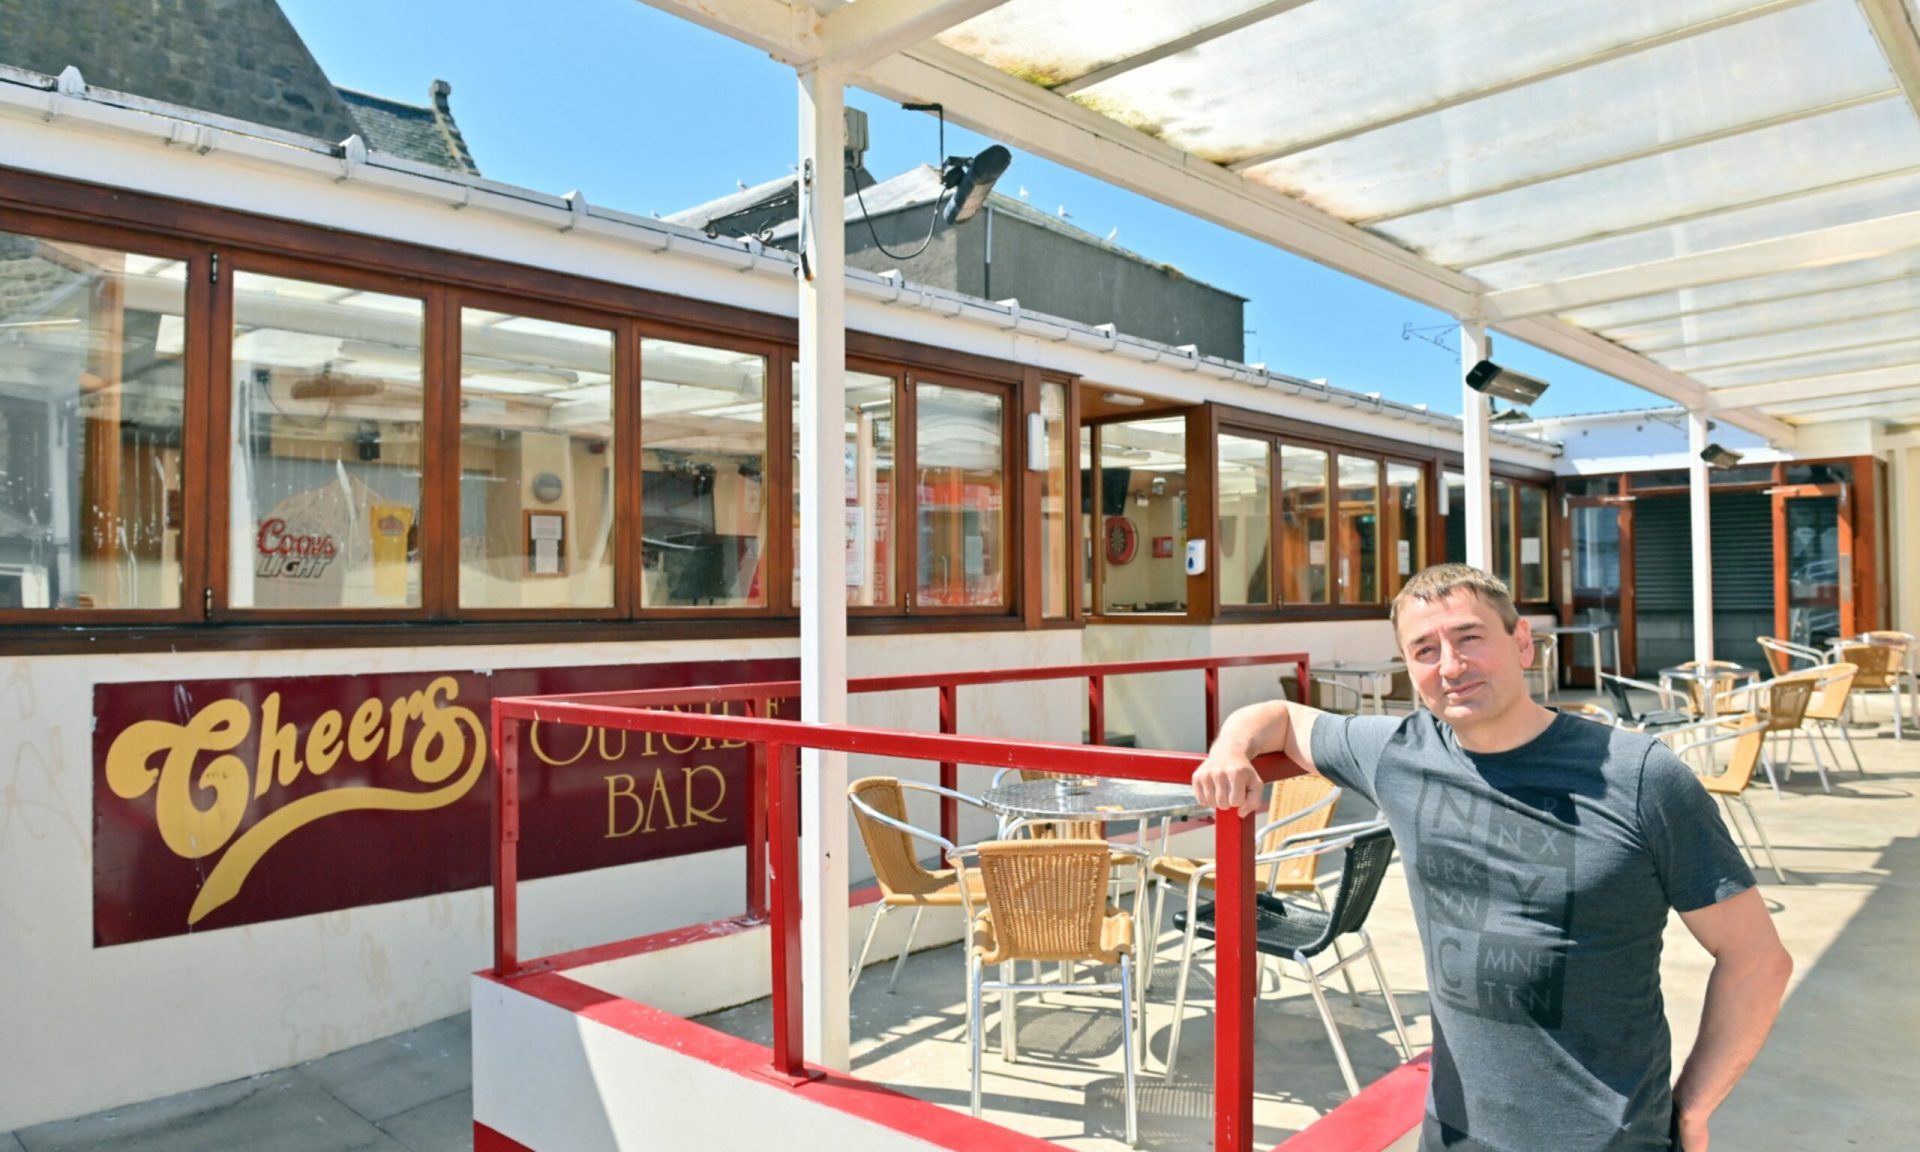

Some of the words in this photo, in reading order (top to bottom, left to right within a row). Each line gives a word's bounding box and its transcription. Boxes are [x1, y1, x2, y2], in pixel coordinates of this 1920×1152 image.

[257, 518, 336, 558] Coors
[256, 556, 332, 579] LIGHT
[530, 697, 786, 767] OUTI
[105, 675, 487, 924] Cheers
[604, 765, 727, 839] BAR
[1425, 854, 1481, 886] BRK
[1438, 935, 1463, 990] C
